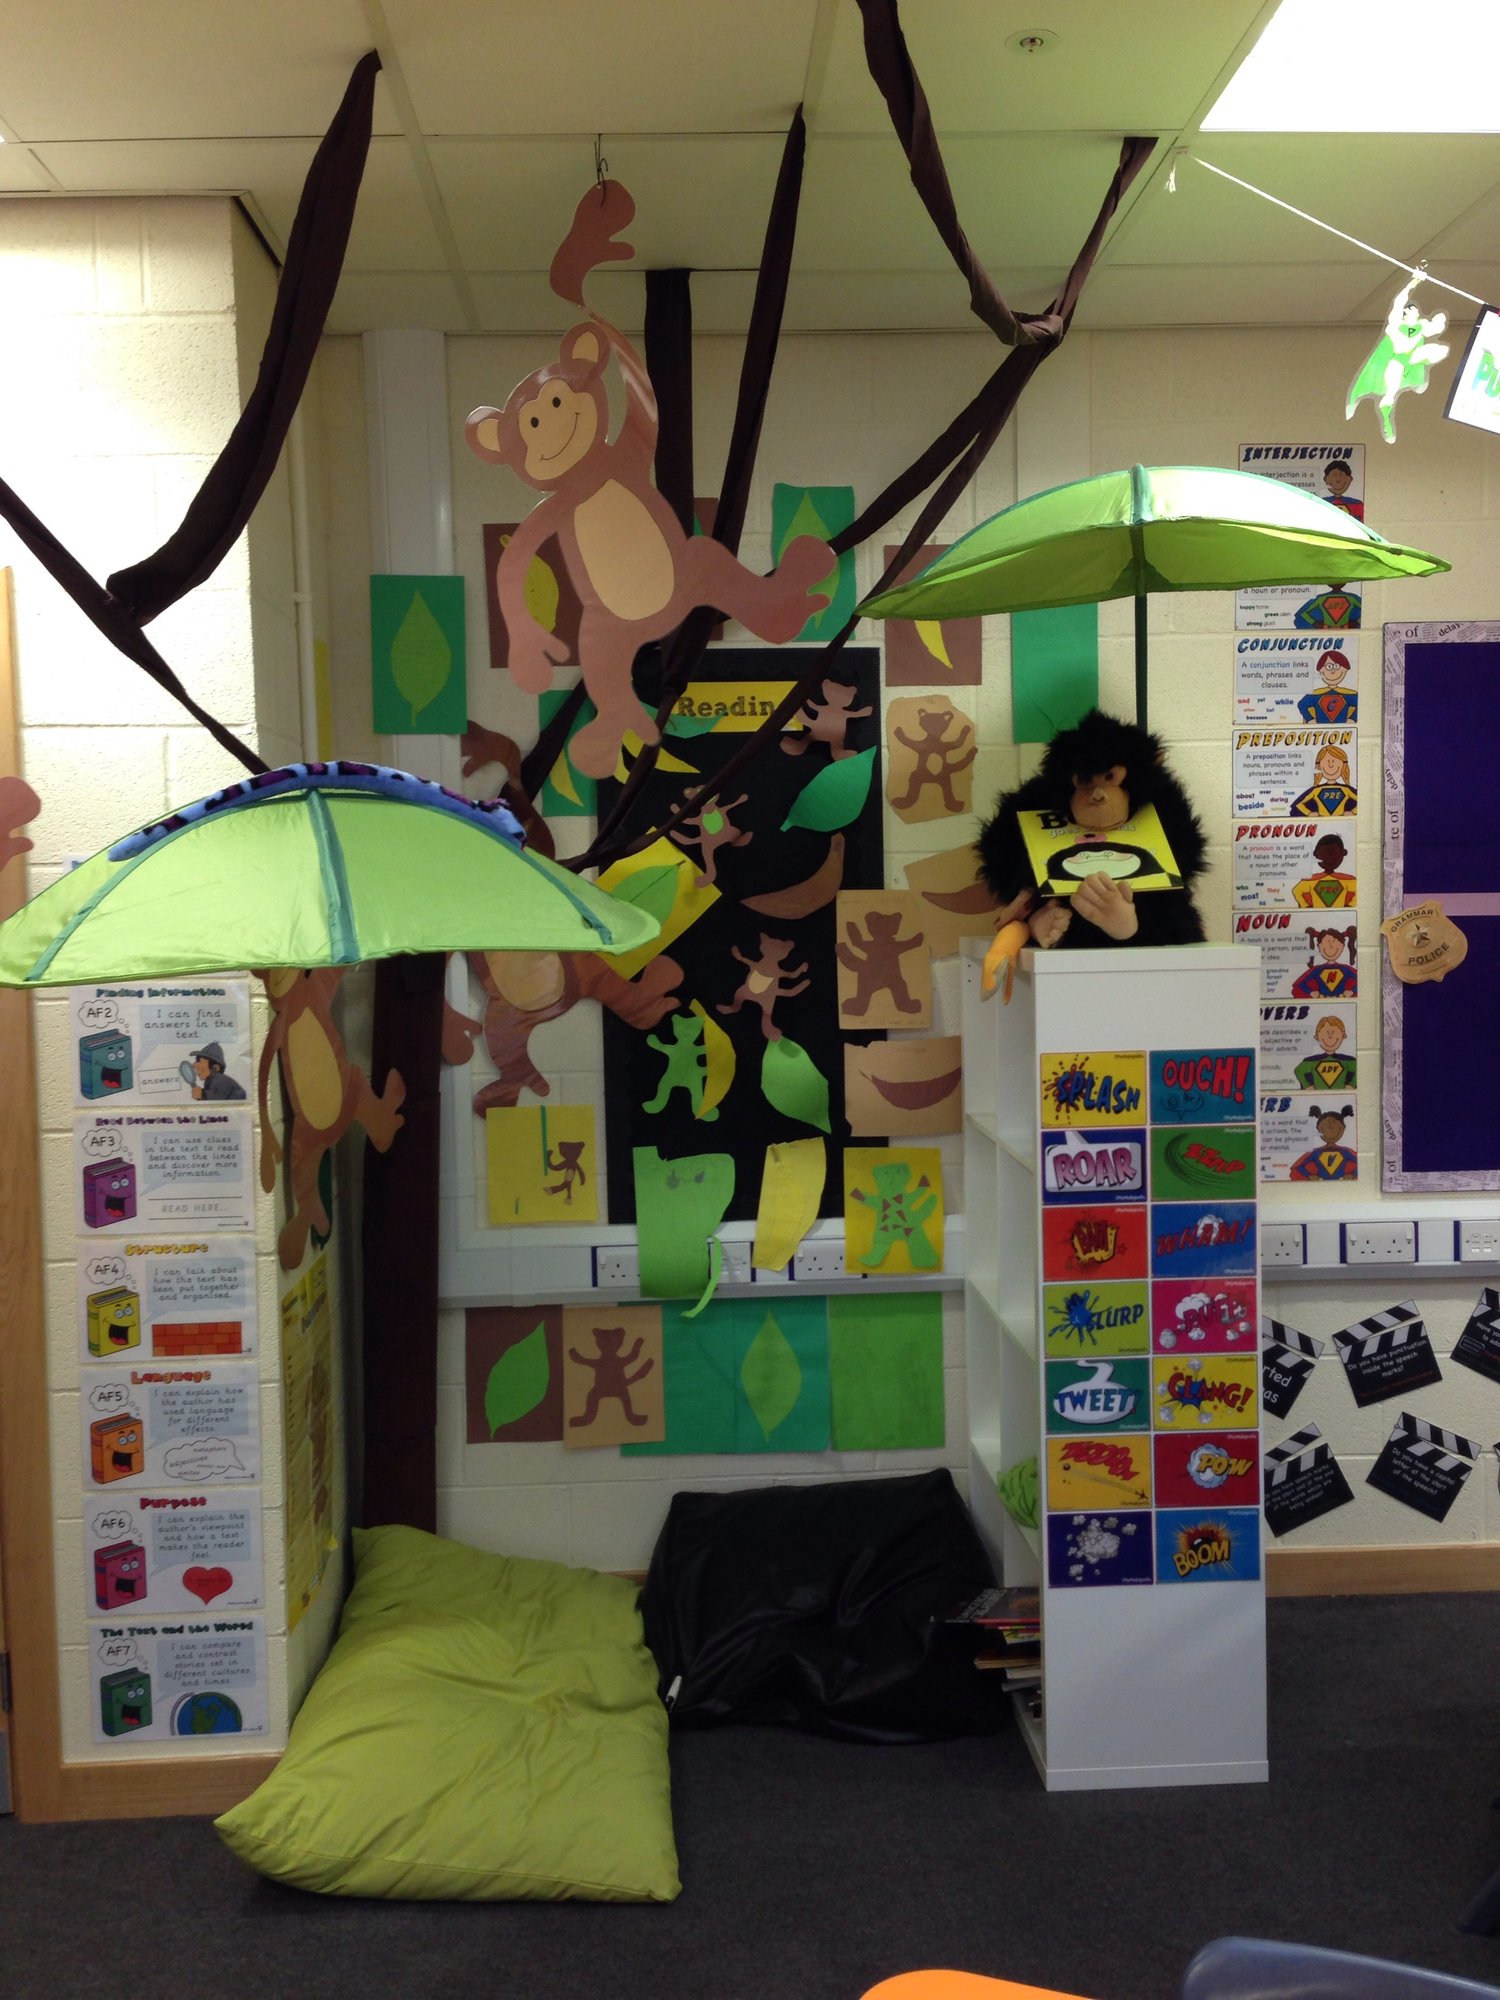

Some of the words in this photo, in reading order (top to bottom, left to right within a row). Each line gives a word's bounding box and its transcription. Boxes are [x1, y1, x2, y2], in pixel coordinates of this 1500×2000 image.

[1243, 446, 1354, 462] INTERJECTION
[1238, 637, 1344, 653] CONJUNCTION
[1250, 661, 1290, 669] conjunction
[1266, 672, 1293, 680] phrases
[677, 696, 776, 717] Readin
[1236, 731, 1353, 750] PREPOSITION
[1253, 753, 1286, 761] preposition
[1238, 801, 1265, 811] beside
[1235, 824, 1318, 841] PRONOUN
[1236, 914, 1292, 933] NOUN
[1390, 909, 1434, 933] GRAMMAR
[1408, 942, 1450, 965] POLICE
[147, 988, 226, 998] Information
[87, 1007, 112, 1018] AF2
[196, 1009, 221, 1021] find
[1260, 1005, 1310, 1020] VERB
[215, 1020, 234, 1028] the
[1321, 1065, 1339, 1073] ADV
[141, 1077, 179, 1086] answers
[1163, 1056, 1250, 1104] OUCH!
[1055, 1069, 1140, 1114] SPLASH
[90, 1136, 116, 1146] AF3
[1053, 1147, 1137, 1190] ROAR
[161, 1204, 189, 1213] READ
[1156, 1217, 1254, 1257] WHAM!
[94, 1264, 119, 1275] AF4
[211, 1266, 237, 1274] about
[200, 1283, 239, 1293] together
[1389, 1340, 1427, 1357] punctuation
[130, 1370, 212, 1385] Language
[98, 1391, 123, 1402] AF5
[185, 1388, 220, 1398] explain
[1168, 1372, 1253, 1413] CLANG!
[190, 1406, 235, 1416] language
[1198, 1453, 1254, 1477] POW
[140, 1496, 207, 1510] Purpose
[100, 1518, 126, 1529] AF6
[189, 1514, 224, 1524] explain
[202, 1522, 245, 1532] viewpoint
[1173, 1538, 1231, 1577] BOOM
[106, 1646, 130, 1656] AF7
[202, 1641, 242, 1651] compare
